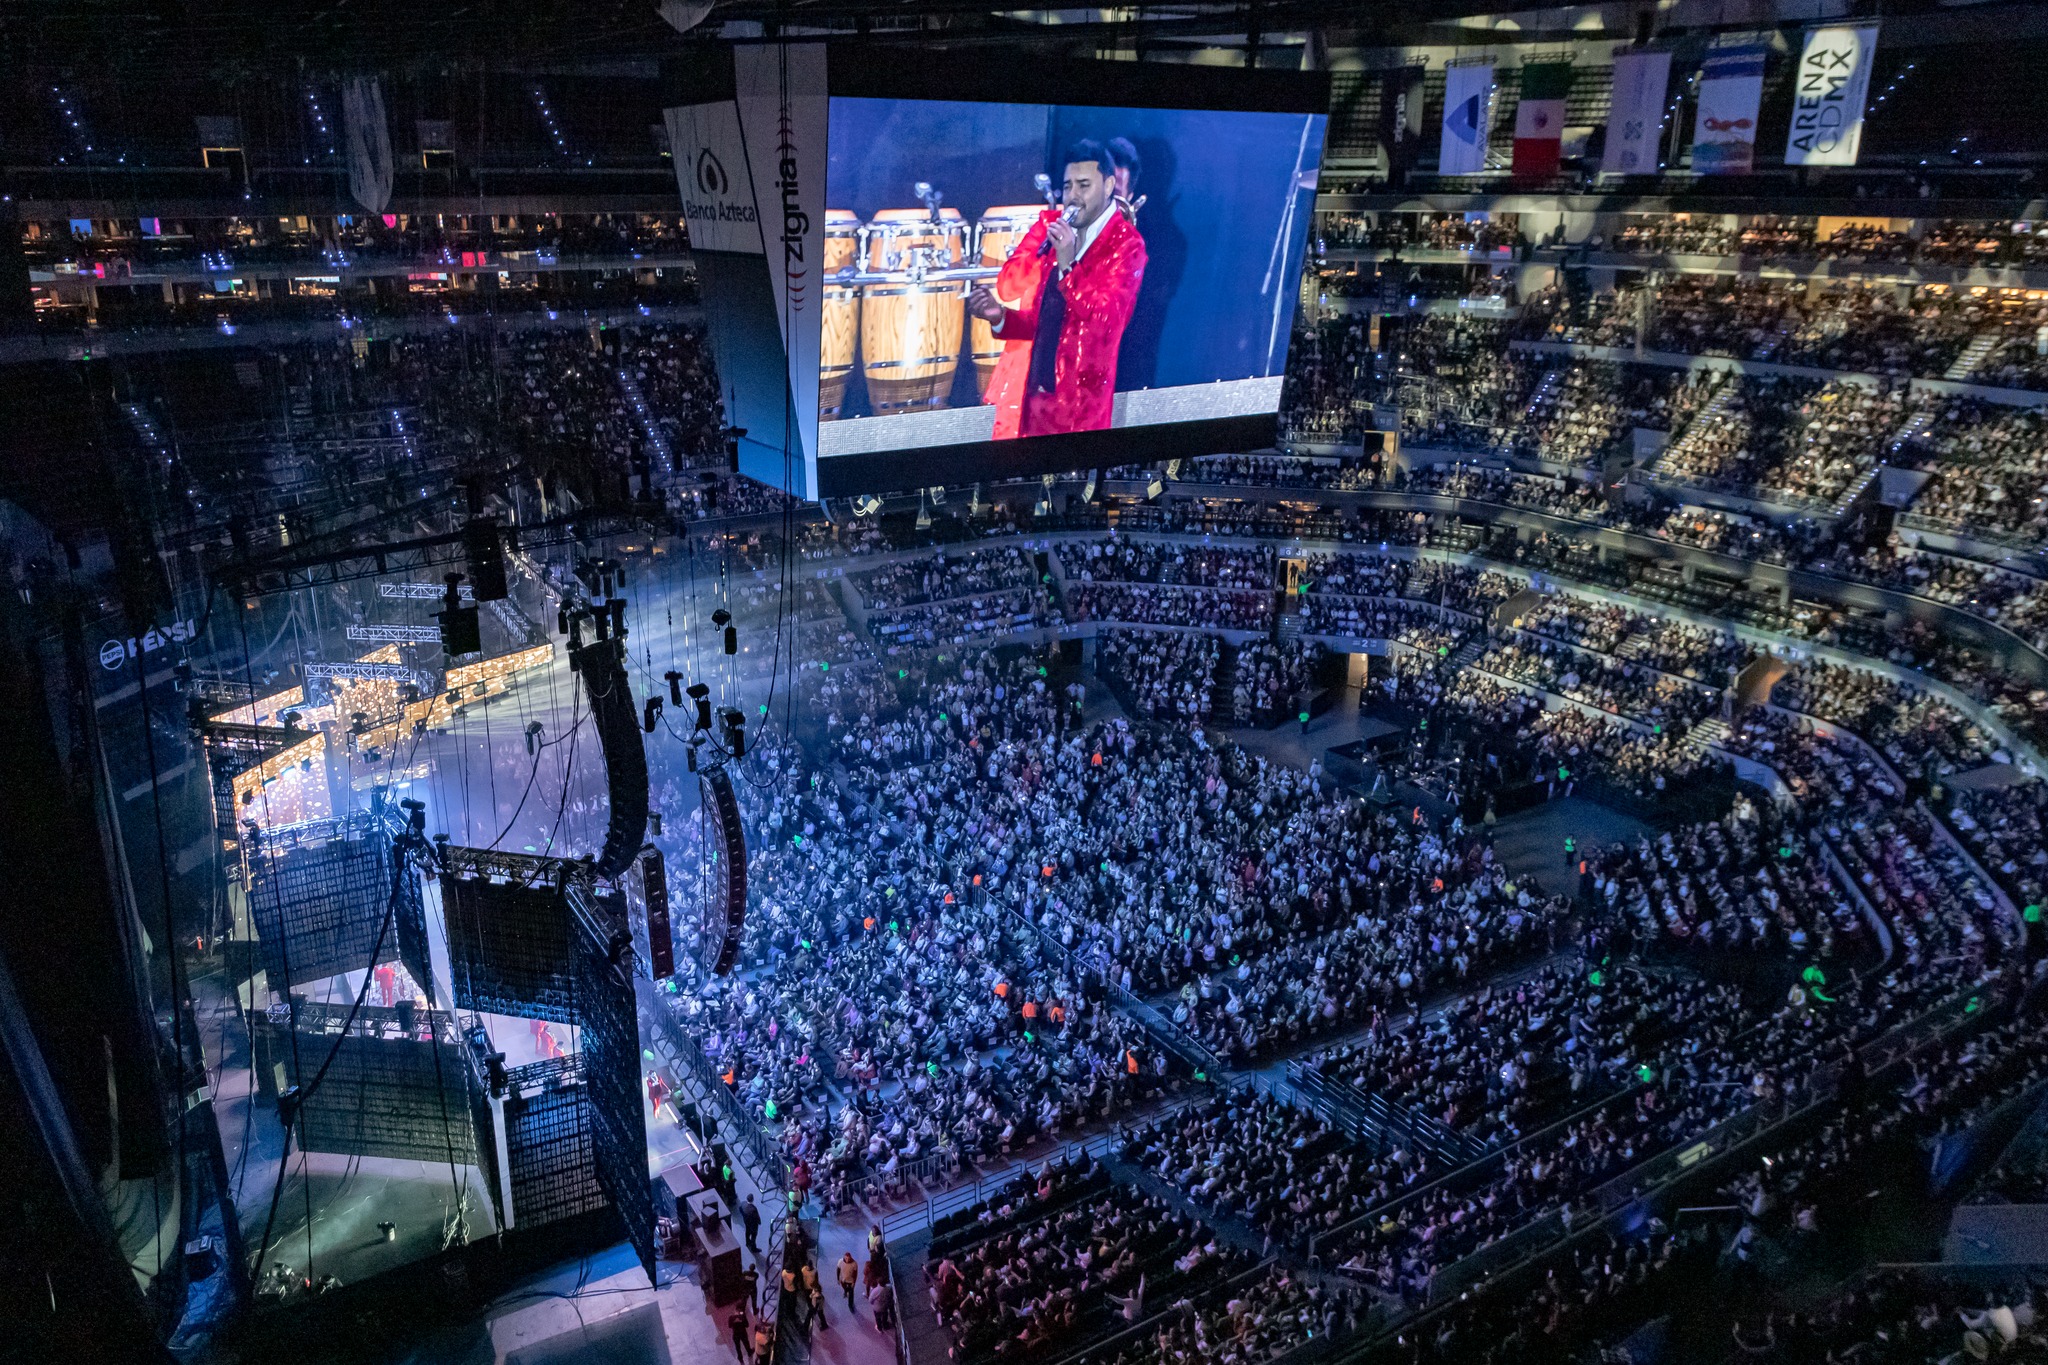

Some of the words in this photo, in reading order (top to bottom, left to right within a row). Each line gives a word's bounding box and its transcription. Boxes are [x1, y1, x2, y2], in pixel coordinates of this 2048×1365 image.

[1793, 48, 1830, 152] ARENA
[1815, 48, 1854, 153] CDMX
[685, 200, 717, 220] Banco
[719, 201, 756, 222] Azteca
[775, 158, 810, 263] zignia
[101, 649, 123, 662] PEPSI
